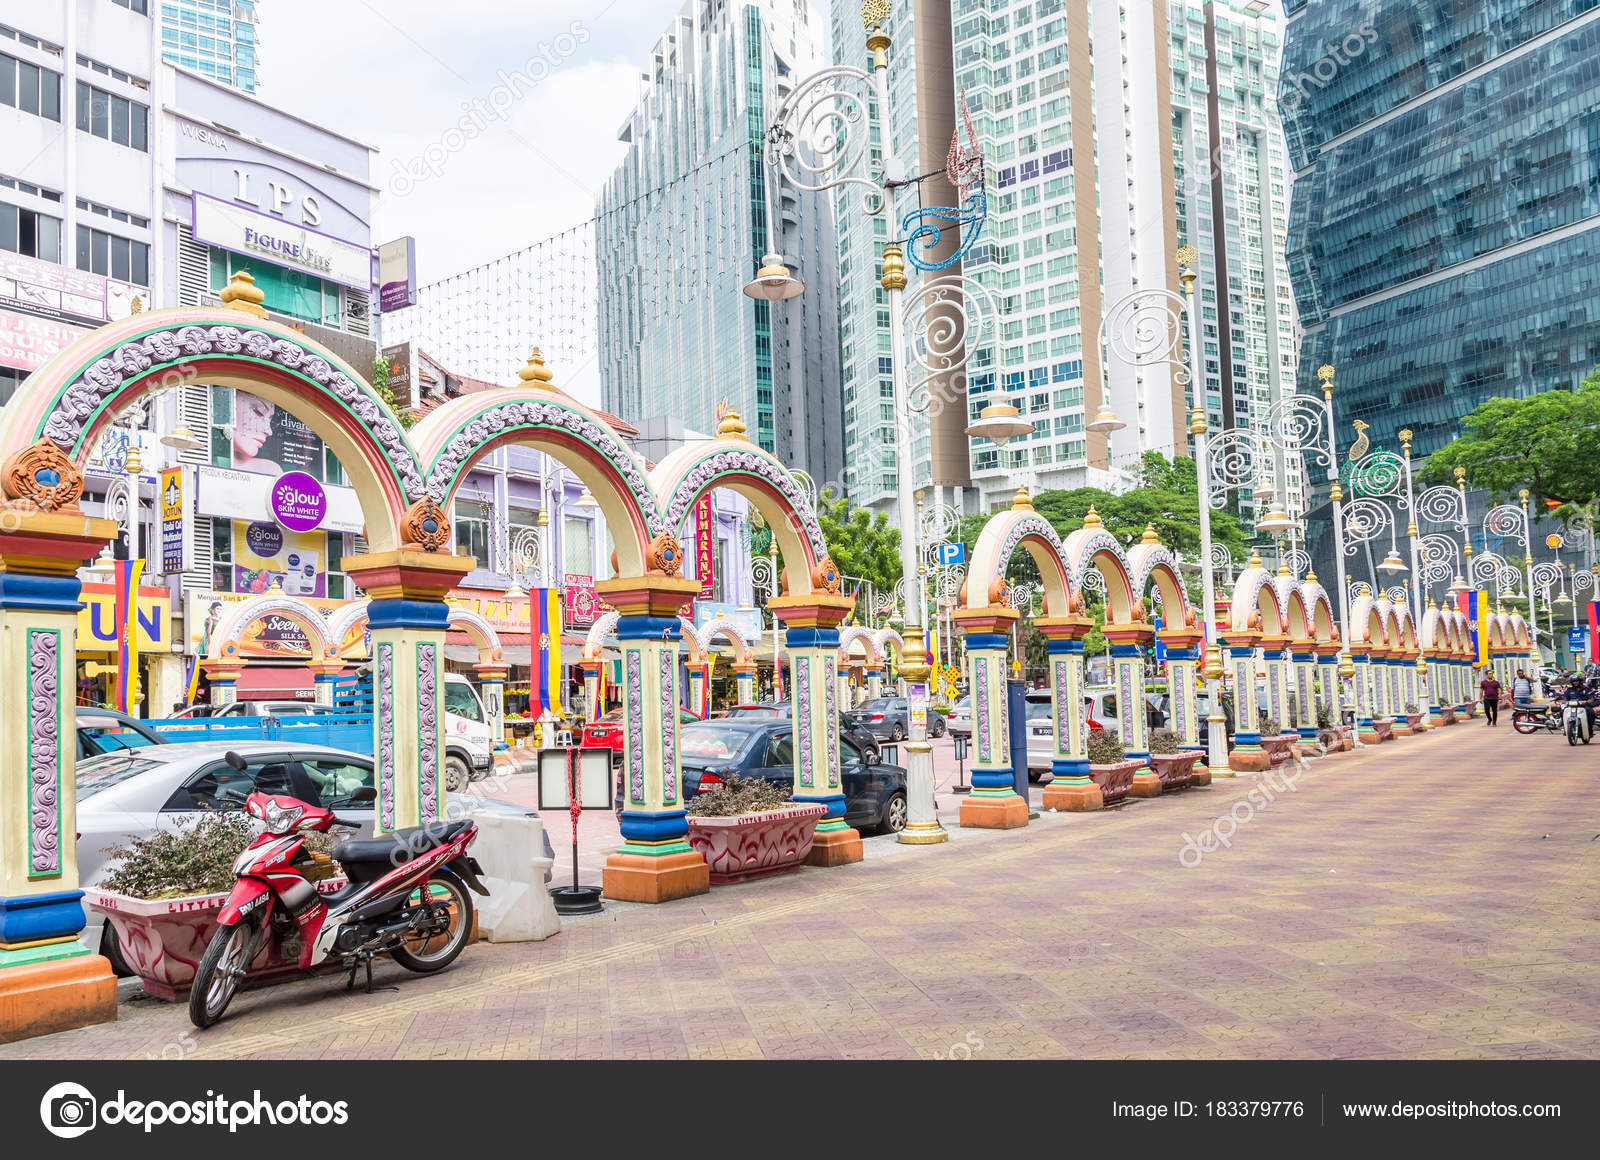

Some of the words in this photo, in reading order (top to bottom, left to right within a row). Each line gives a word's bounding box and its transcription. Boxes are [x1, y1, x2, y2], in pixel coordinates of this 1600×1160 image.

[179, 122, 228, 151] WISMA
[245, 227, 300, 257] FIGURE
[285, 489, 320, 506] glow
[163, 506, 182, 519] JOTUN
[278, 504, 296, 514] SKIN
[296, 506, 320, 517] WHITE
[255, 530, 280, 542] glow
[944, 544, 959, 564] P
[77, 602, 160, 642] UN
[168, 898, 226, 912] LITTLE
